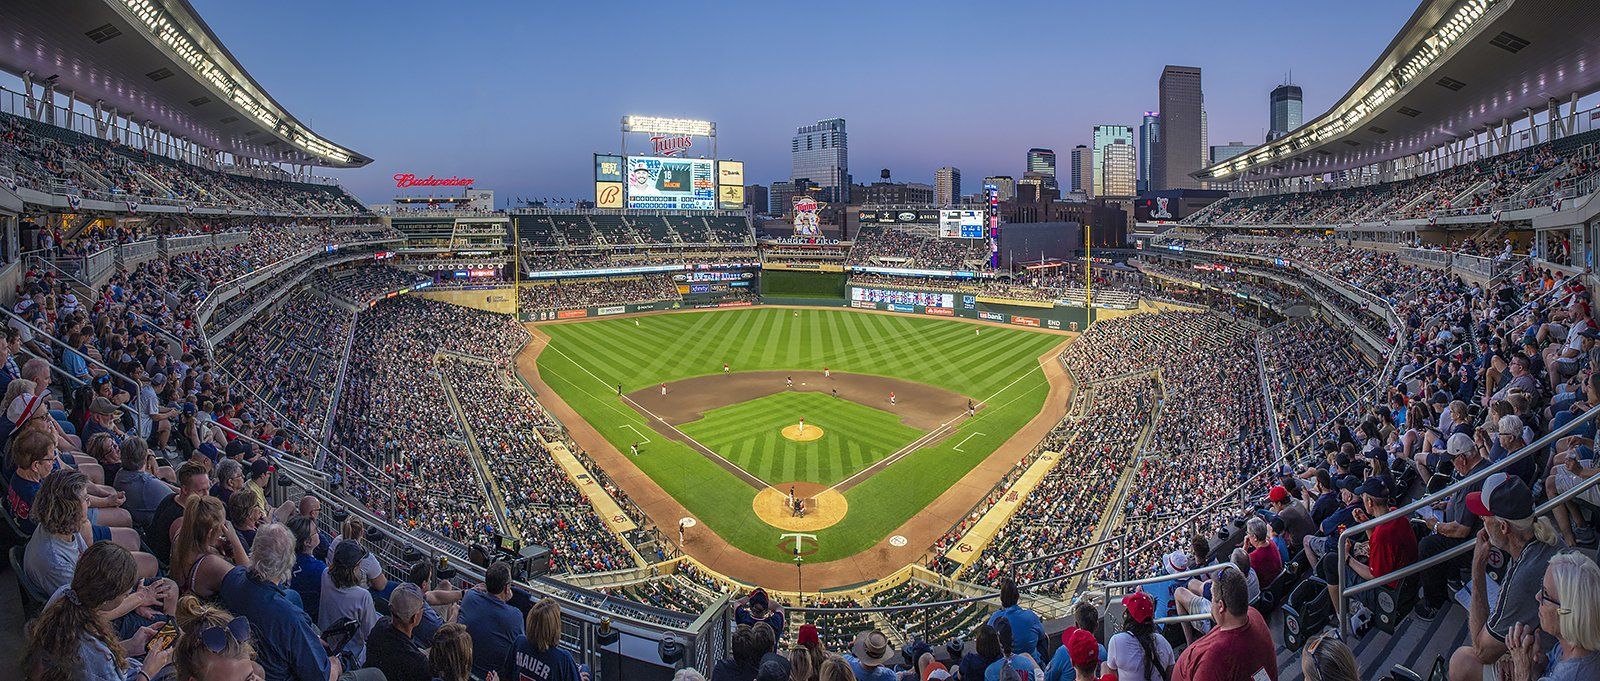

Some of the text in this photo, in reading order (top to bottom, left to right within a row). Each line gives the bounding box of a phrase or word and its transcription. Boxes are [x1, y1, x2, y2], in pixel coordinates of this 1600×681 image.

[650, 136, 692, 154] Twins
[393, 173, 475, 188] Budweiser
[796, 203, 817, 212] Twins
[777, 237, 808, 245] TARGET
[515, 651, 551, 680] MAUER
